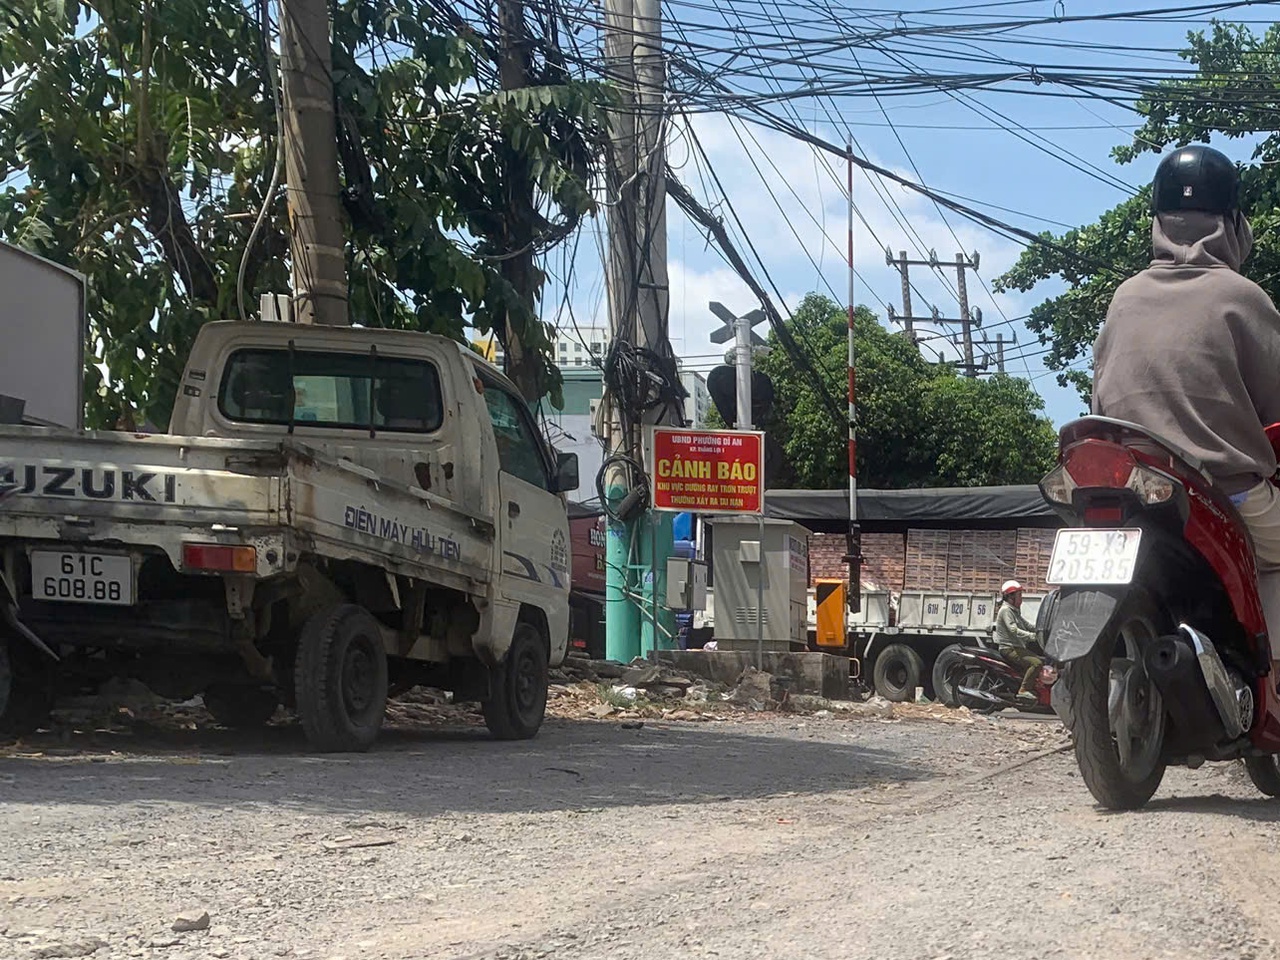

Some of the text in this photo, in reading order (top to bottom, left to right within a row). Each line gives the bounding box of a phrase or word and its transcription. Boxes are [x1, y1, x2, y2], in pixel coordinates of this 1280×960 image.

[672, 435, 691, 444] UBND
[693, 435, 721, 445] PHƯỜNG
[732, 438, 743, 447] AN
[658, 453, 756, 481] CẢNH BÁO
[657, 482, 670, 491] KHU
[380, 516, 408, 543] MÁY
[61, 554, 104, 576] 61C
[44, 576, 121, 601] 608.88
[927, 603, 987, 616] 61H 020 56
